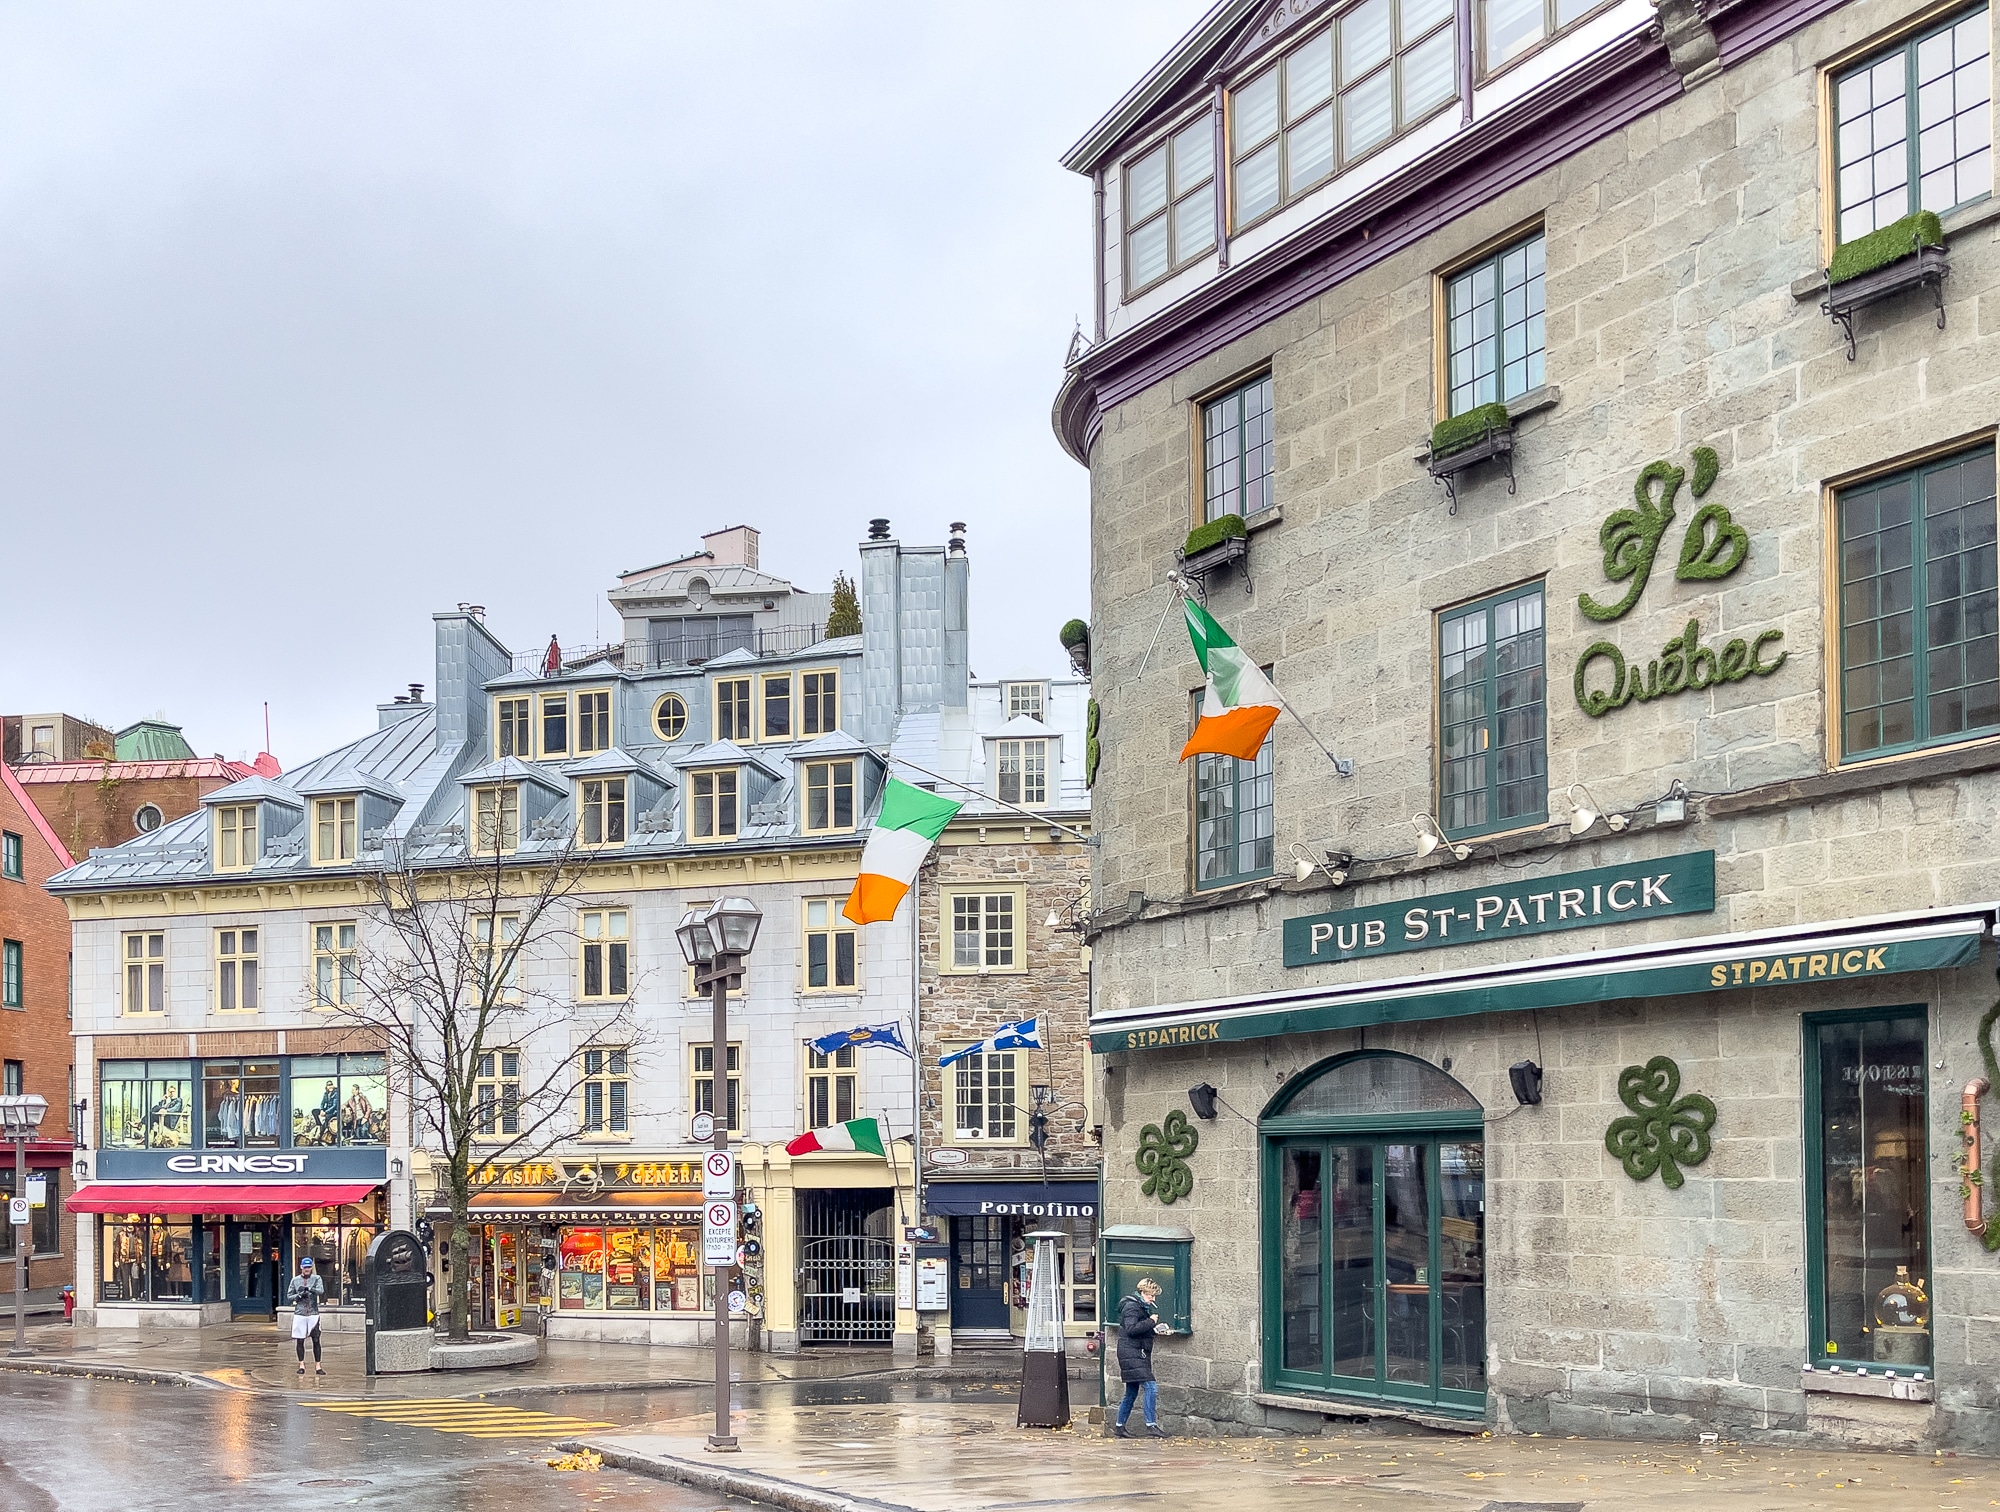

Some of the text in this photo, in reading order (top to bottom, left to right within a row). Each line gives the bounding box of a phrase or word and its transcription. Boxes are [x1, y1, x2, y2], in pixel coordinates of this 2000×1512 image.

[1574, 618, 1787, 717] Québec
[1749, 946, 1889, 984] PATRICK
[1148, 1022, 1220, 1046] PATRICK
[166, 1154, 309, 1173] ERNEST
[980, 1201, 1094, 1217] Portofino
[708, 1228, 732, 1236] EXCEPTÉ
